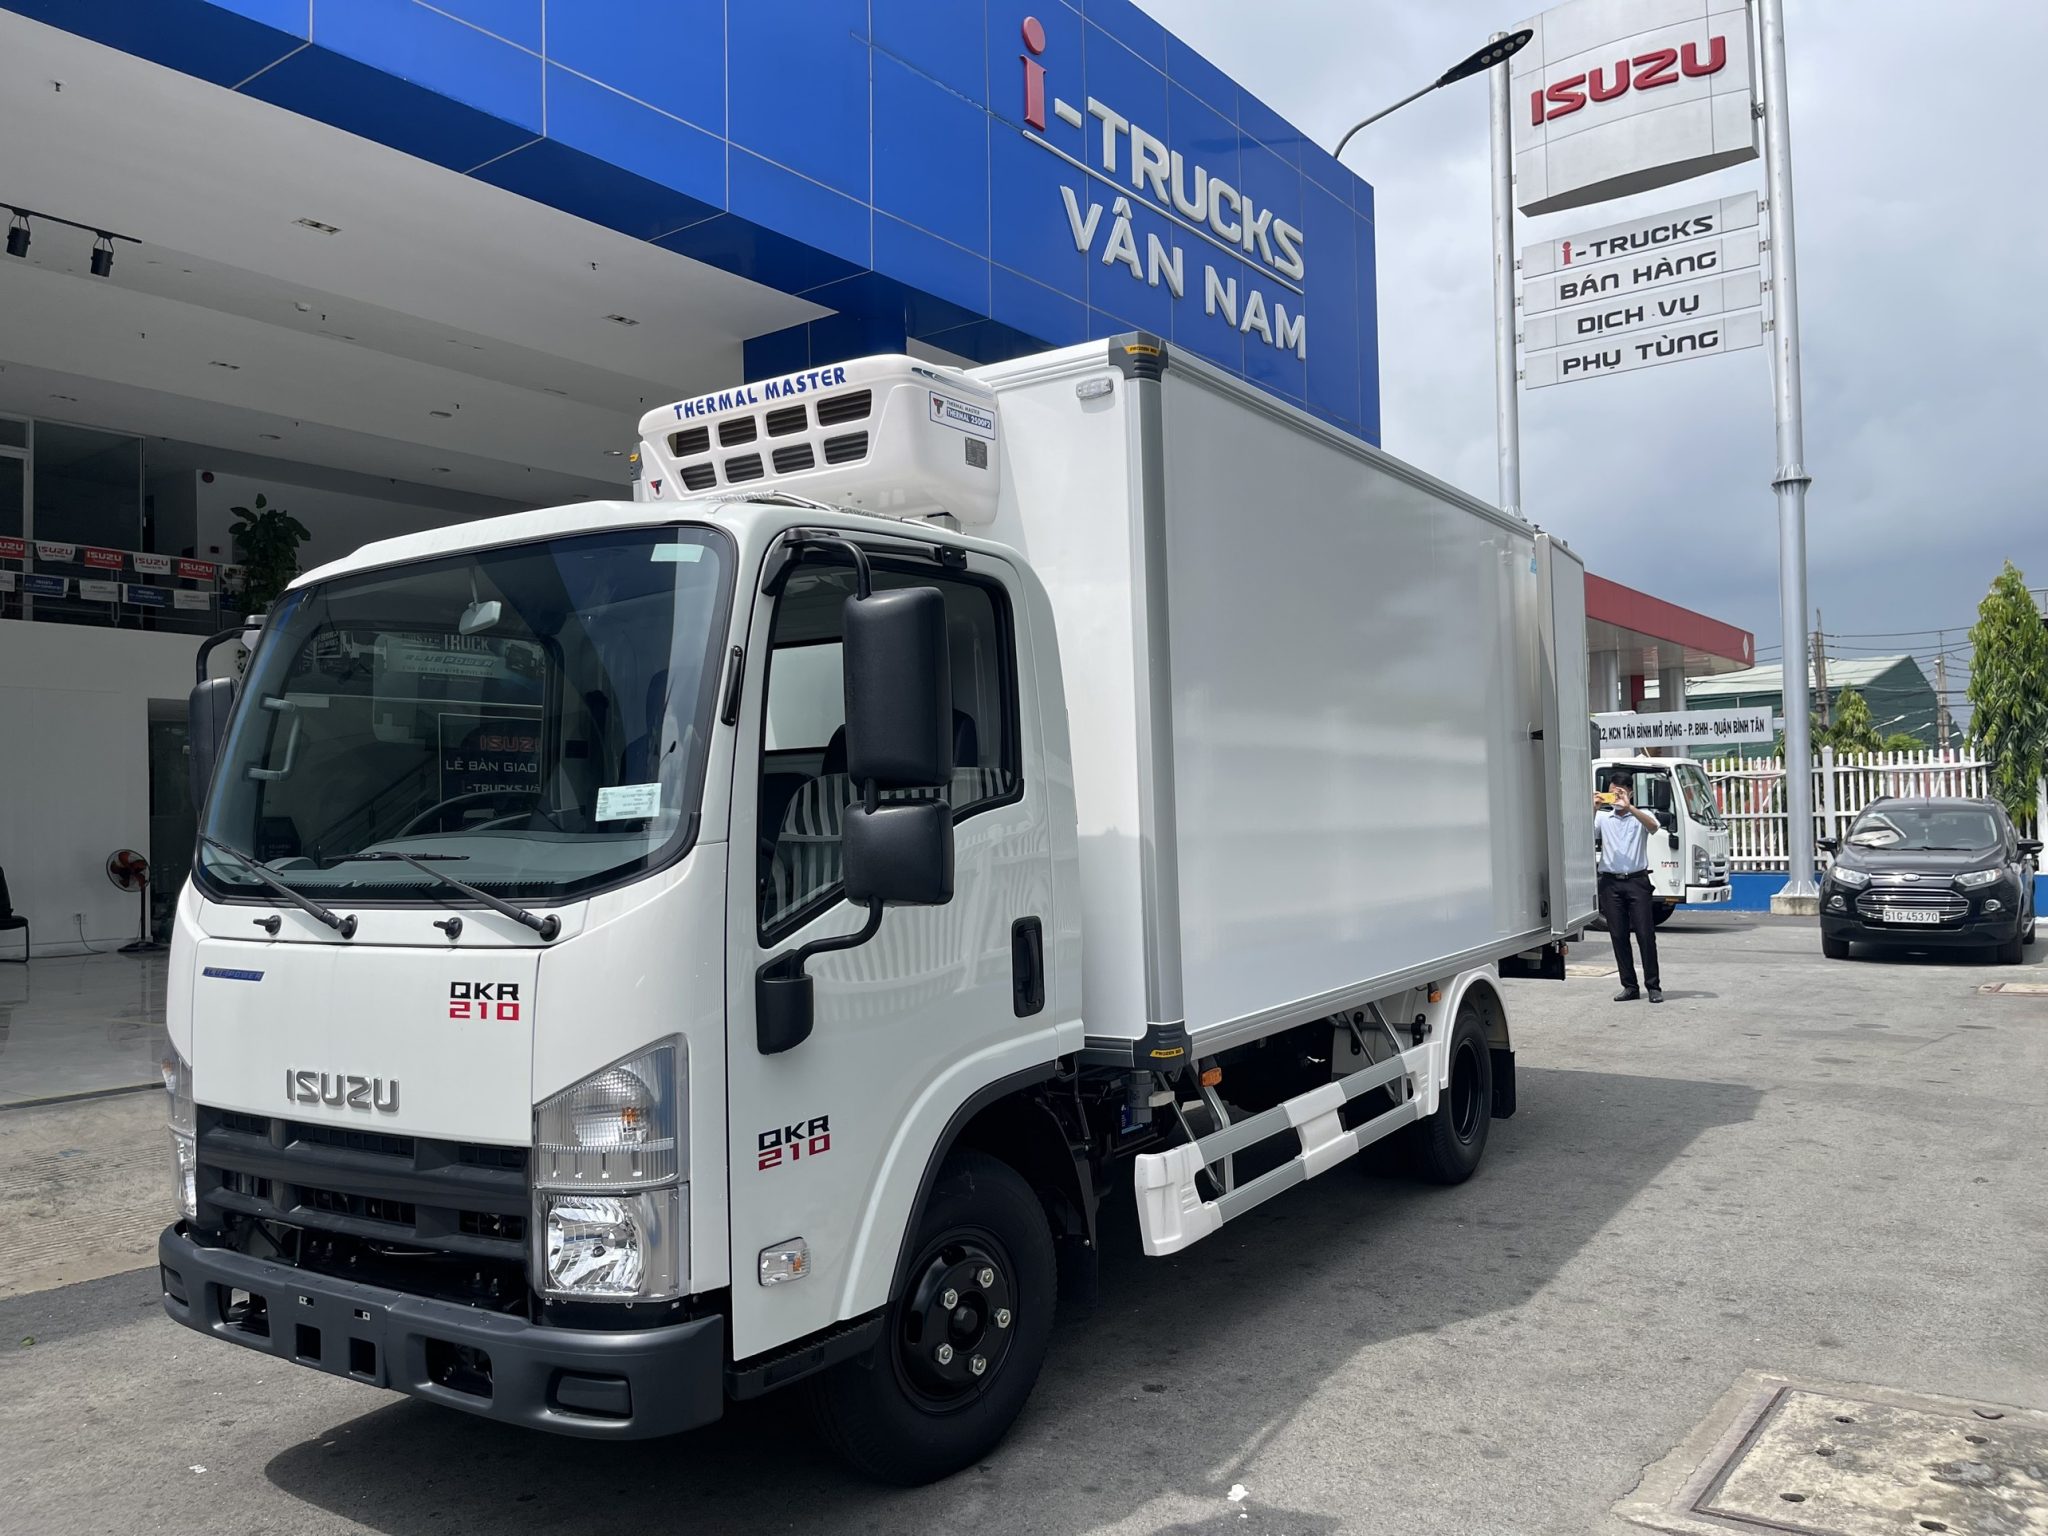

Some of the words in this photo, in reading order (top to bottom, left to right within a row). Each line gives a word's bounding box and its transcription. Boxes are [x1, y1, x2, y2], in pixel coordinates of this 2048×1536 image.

[1530, 36, 1727, 127] ISUZU
[1020, 16, 1304, 282] i-TRUCKS
[1561, 215, 1714, 266] i-TRUCKS
[1059, 185, 1184, 299] VÂN
[1204, 265, 1306, 361] NAM
[1560, 273, 1619, 300] BÁN
[1632, 251, 1718, 285] HÀNG
[1577, 306, 1644, 334] DỊCH
[1657, 294, 1700, 316] VỤ
[1563, 349, 1621, 375] PHỤ
[1635, 330, 1719, 361] TÙNG
[673, 387, 759, 420] THERMAL
[764, 366, 847, 400] MASTER
[38, 546, 73, 555] ISUZU
[87, 551, 122, 561] ISUZU
[135, 557, 169, 566] ISUZU
[180, 562, 213, 573] ISUZU
[1609, 727, 1621, 740] KCN
[1622, 723, 1636, 739] TÂN
[1637, 722, 1652, 738] BÌNH
[1665, 720, 1682, 740] RỘNG
[1714, 718, 1732, 738] QUẬN
[1733, 717, 1749, 733] BÌNH
[1750, 716, 1765, 732] TÂN
[468, 757, 498, 771] BÀN
[503, 762, 537, 773] GIAO
[450, 982, 519, 1001] QKR
[449, 1001, 519, 1021] 210
[286, 1068, 400, 1113] ISUZU
[758, 1115, 830, 1151] QKR
[758, 1134, 831, 1171] 210
